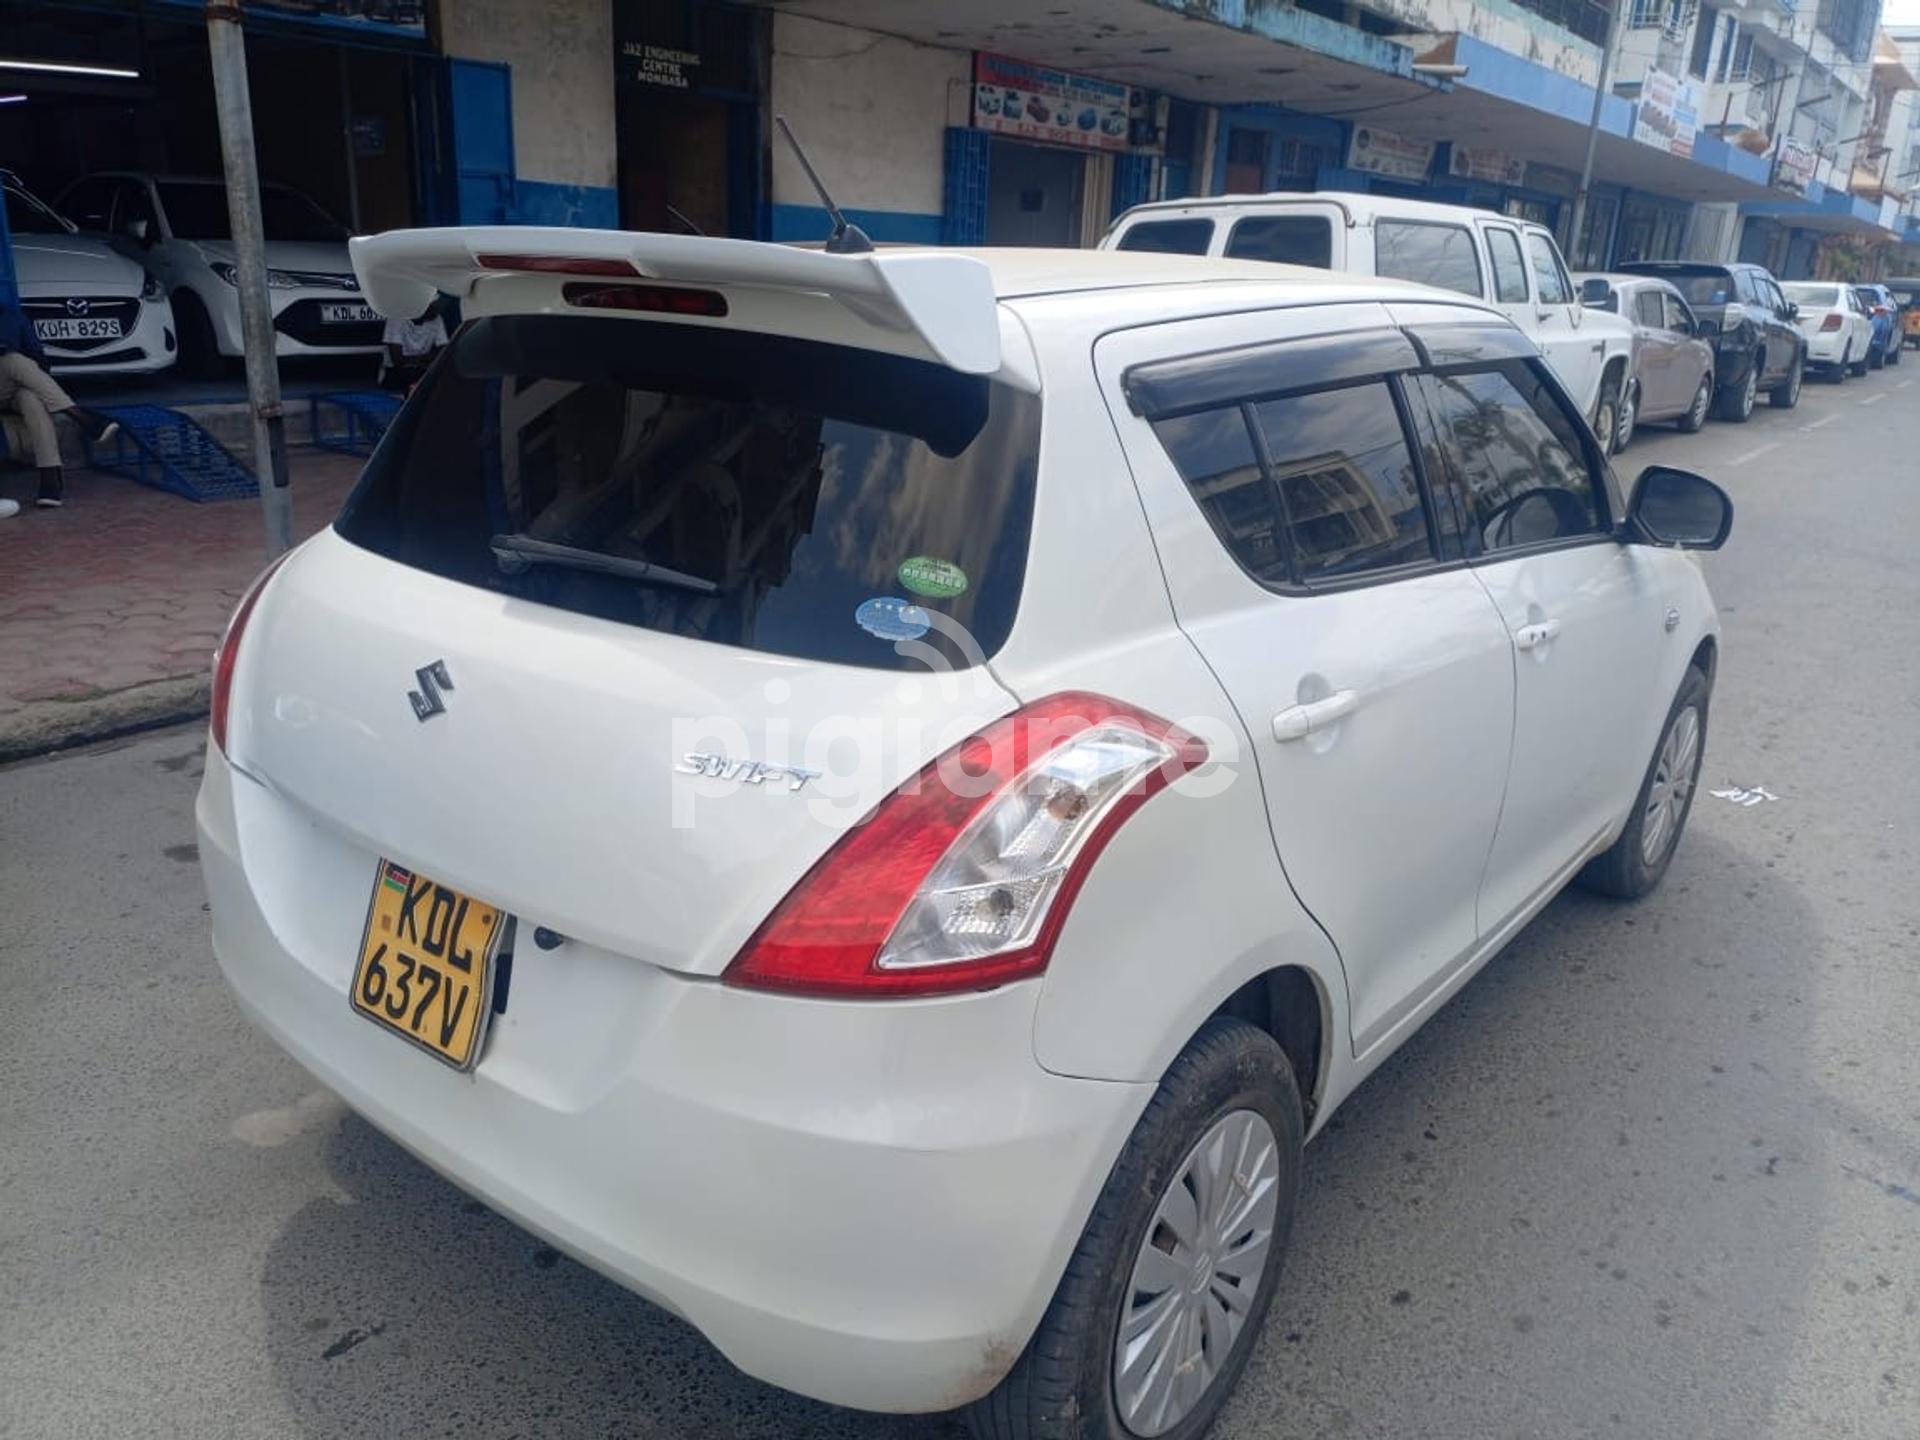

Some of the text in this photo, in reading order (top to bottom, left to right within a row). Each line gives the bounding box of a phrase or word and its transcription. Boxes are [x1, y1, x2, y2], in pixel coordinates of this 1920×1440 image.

[643, 59, 681, 76] CENTRE
[638, 70, 688, 88] MOMBASA
[334, 306, 356, 320] KDL
[37, 320, 119, 337] KDH 829S
[675, 751, 823, 792] SWIFT
[397, 872, 473, 975] KDL
[362, 943, 470, 1049] 637V
